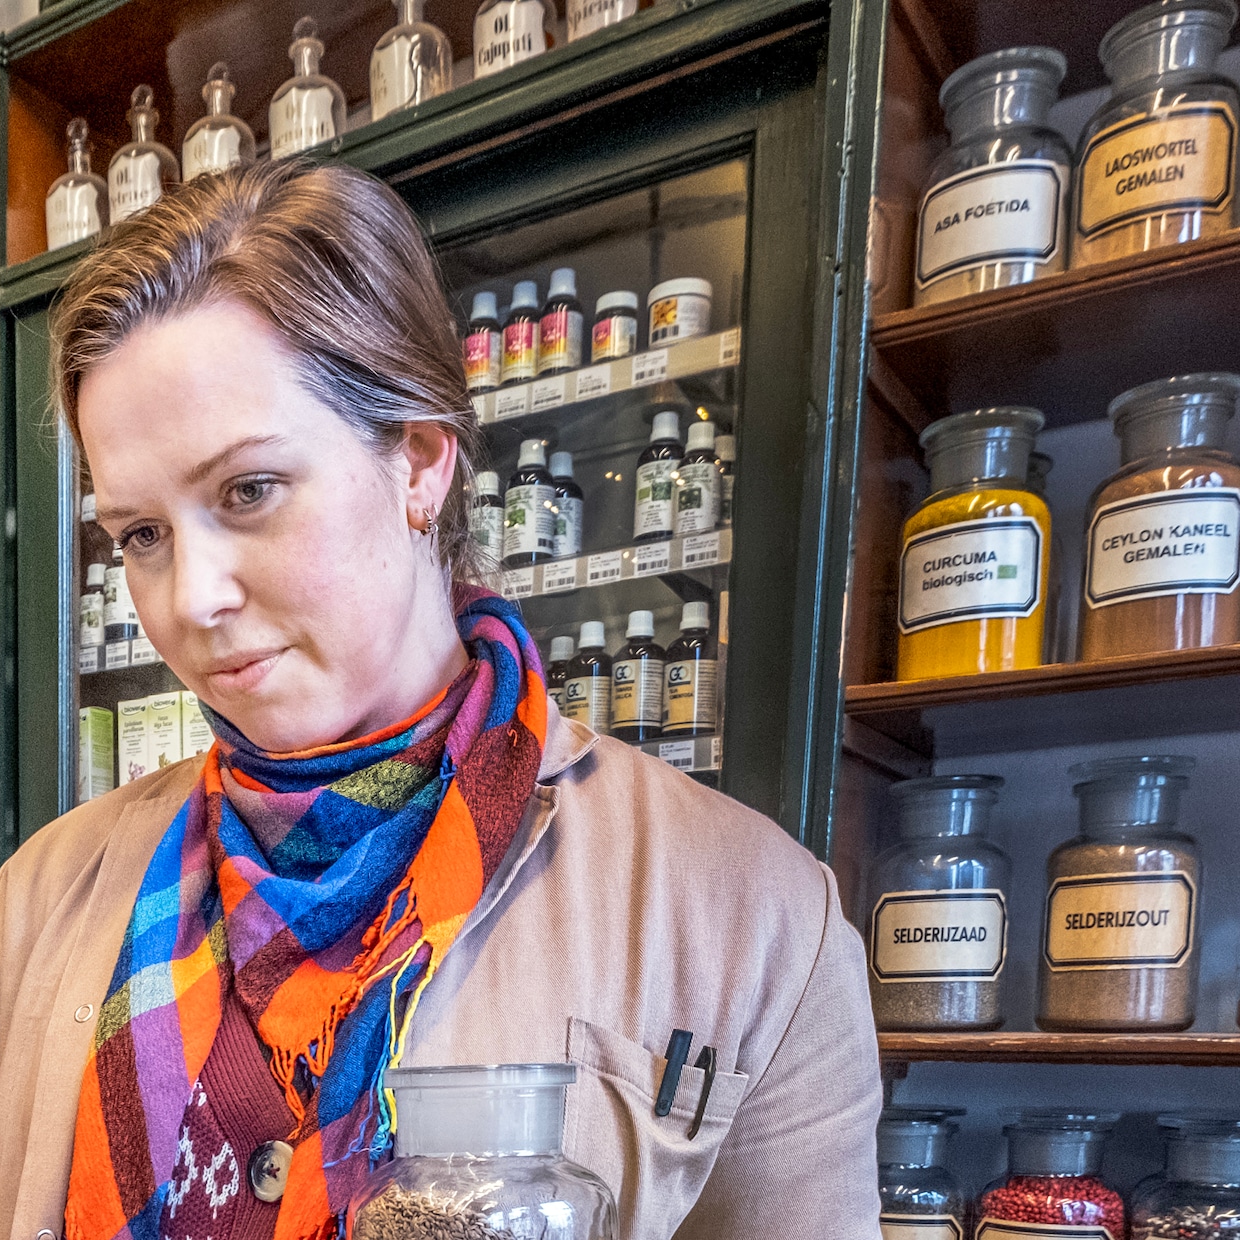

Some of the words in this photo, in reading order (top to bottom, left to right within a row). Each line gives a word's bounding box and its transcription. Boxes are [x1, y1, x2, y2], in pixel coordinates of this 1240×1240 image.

[1105, 138, 1198, 178] LAOSWORTEL
[1115, 166, 1184, 196] GEMALEN
[934, 212, 963, 234] ASA
[1101, 527, 1164, 553] CEYLON
[1169, 523, 1233, 541] KANEEL
[922, 550, 998, 575] CURCUMA
[1123, 543, 1206, 565] GEMALEN
[921, 568, 993, 592] biologisch
[1065, 909, 1170, 930] SELDERIJZOUT
[893, 926, 987, 945] SELDERIJZAAD
